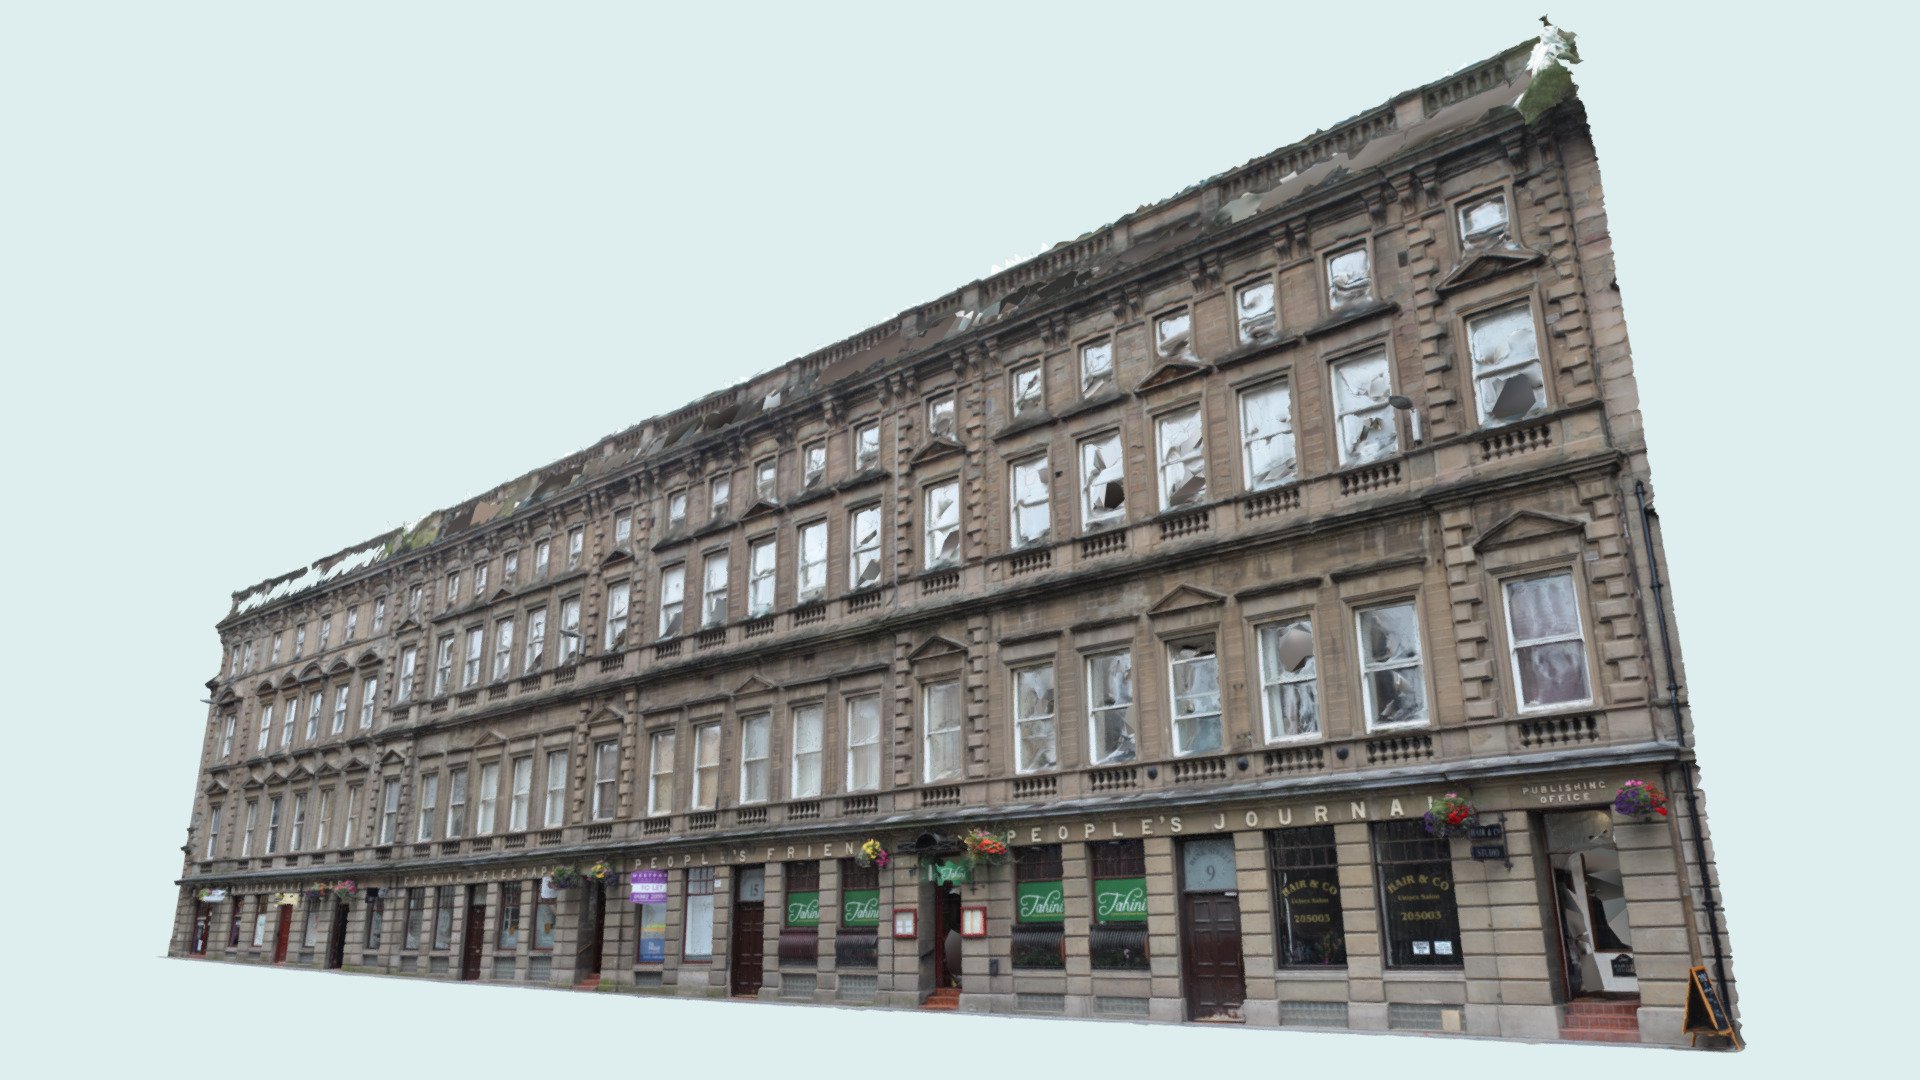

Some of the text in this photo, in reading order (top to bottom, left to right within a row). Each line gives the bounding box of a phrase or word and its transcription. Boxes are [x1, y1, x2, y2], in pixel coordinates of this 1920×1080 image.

[1522, 781, 1607, 796] PUBLISHING
[1540, 792, 1592, 804] OFFICE
[1006, 816, 1182, 845] PEOPLE'S
[767, 842, 854, 860] FRIEN
[404, 873, 462, 886] EVENING
[942, 866, 966, 880] Tahini
[1206, 864, 1216, 881] 9
[750, 884, 760, 897] 15
[1282, 879, 1338, 897] HAIR & CO
[1387, 874, 1450, 894] HAIR & CO
[1020, 889, 1065, 917] Tahini
[1098, 888, 1148, 915] Tahini
[788, 899, 820, 923] Tahin
[1293, 914, 1331, 923] 205003
[1401, 911, 1442, 921] 205003
